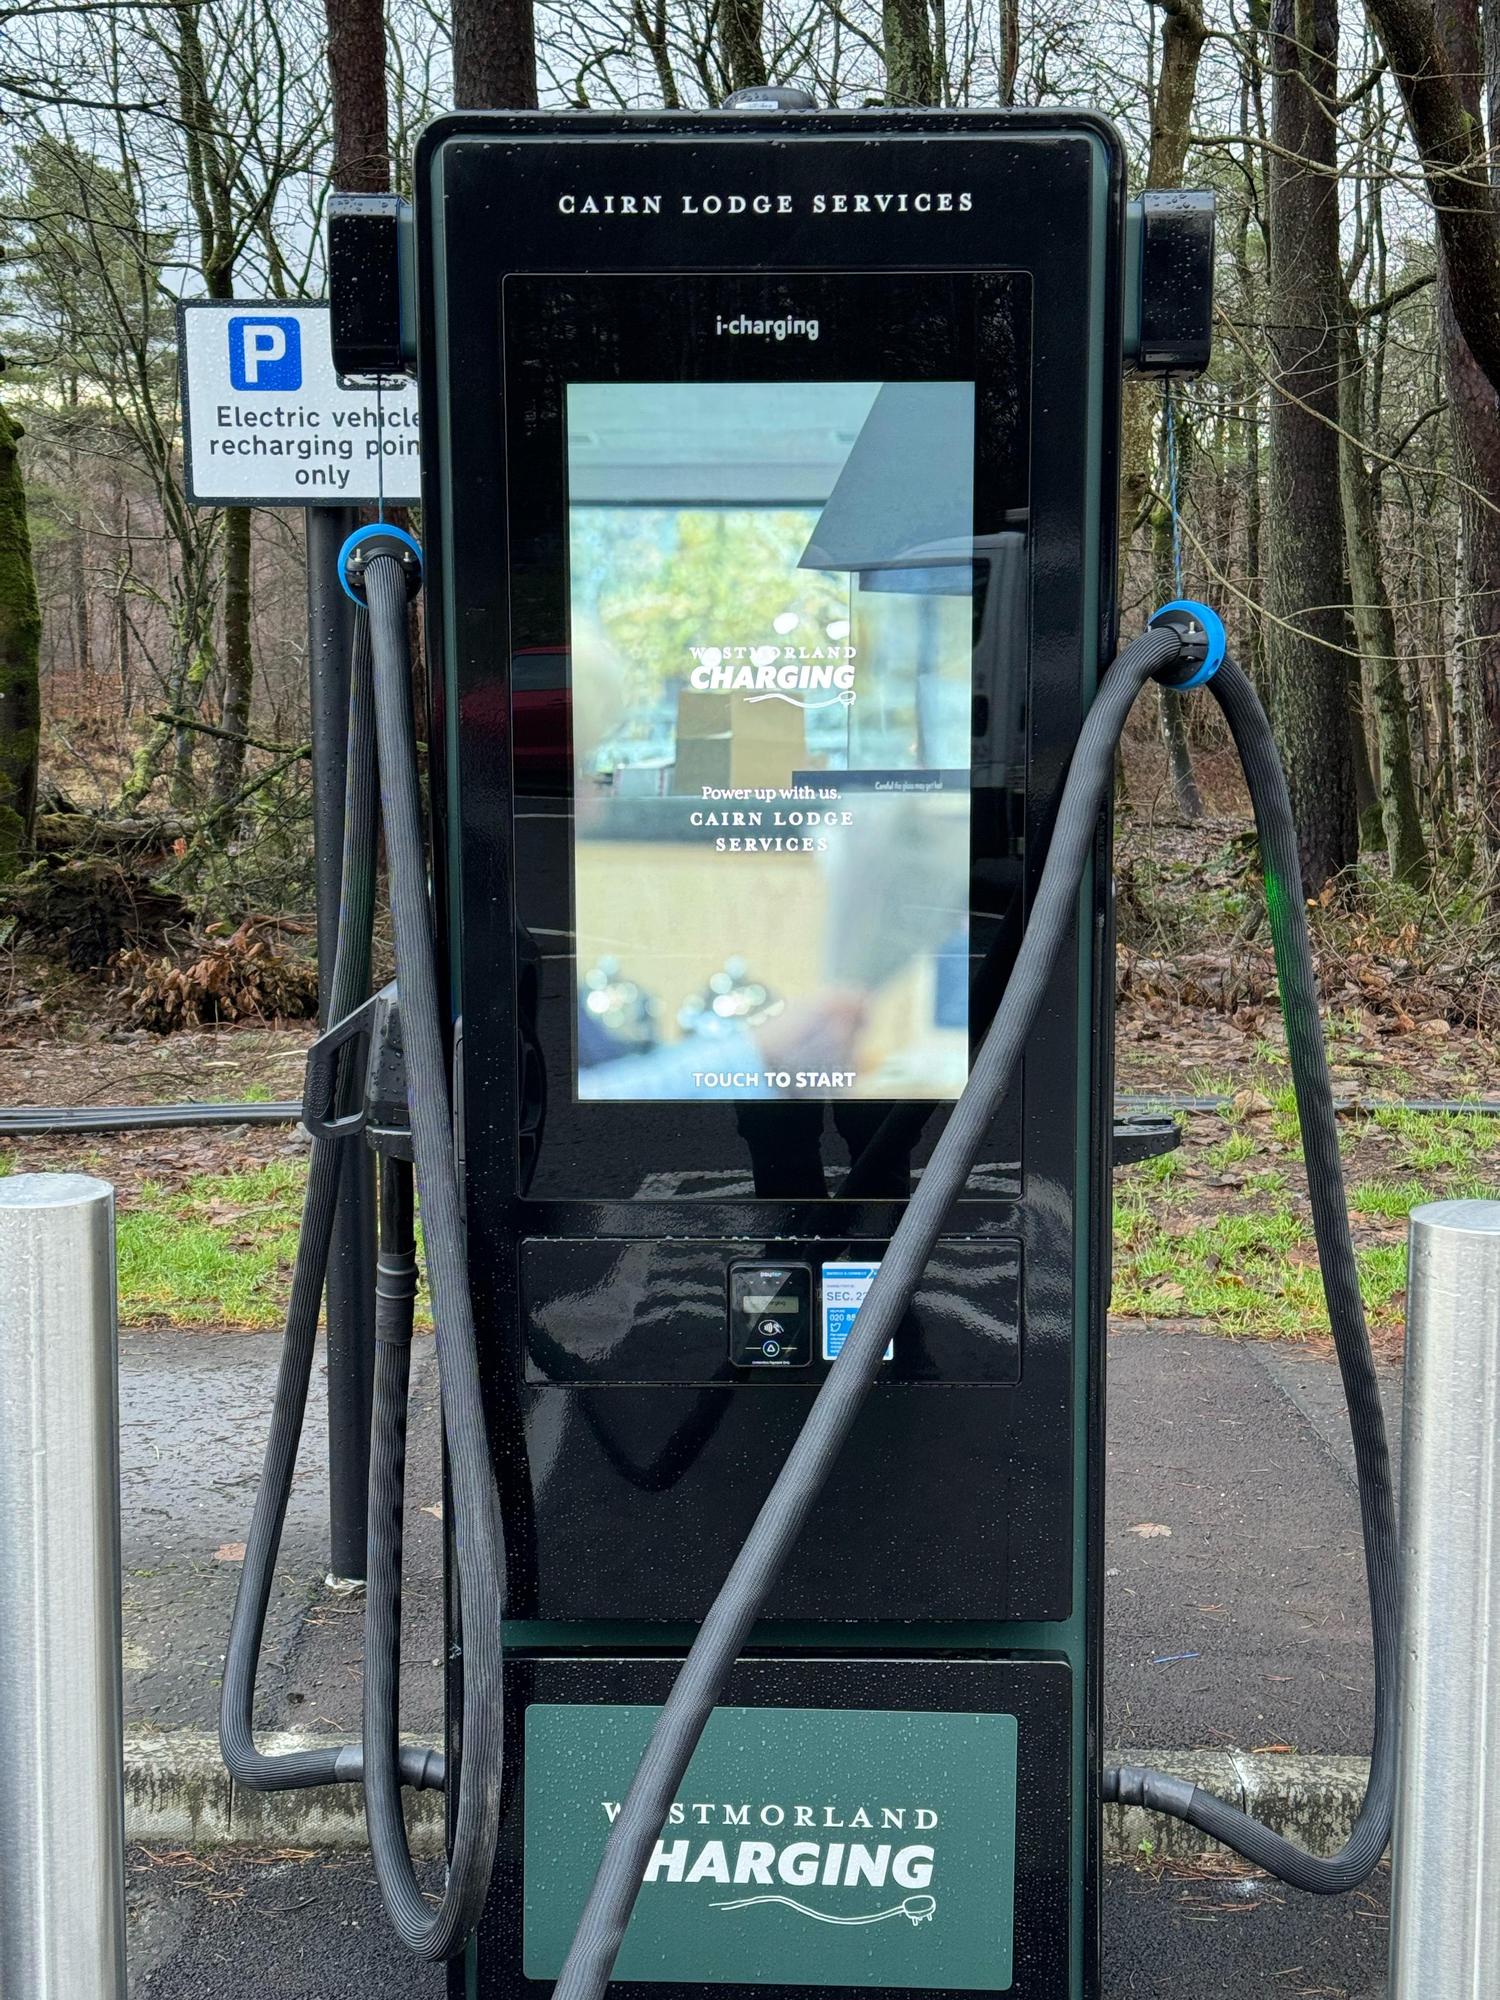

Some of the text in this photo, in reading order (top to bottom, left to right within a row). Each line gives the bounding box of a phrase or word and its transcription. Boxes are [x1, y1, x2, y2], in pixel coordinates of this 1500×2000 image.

[558, 192, 973, 214] CAIRN LODGE SERVICES
[716, 314, 819, 341] i-charging
[242, 324, 287, 384] P
[216, 405, 420, 428] Electric vehicle
[209, 434, 421, 460] recharging poin
[295, 464, 350, 489] only
[688, 646, 857, 660] WSTORLAND
[689, 664, 856, 690] CHARGING
[702, 785, 842, 803] Power up with us.
[689, 811, 854, 827] CAIRN LODGE
[715, 837, 829, 852] SERVICES
[692, 1071, 857, 1088] TOUCH TO START
[826, 1291, 868, 1302] SEC. 2
[600, 1801, 938, 1830] WSTMORLAND
[642, 1839, 935, 1889] HARGING
